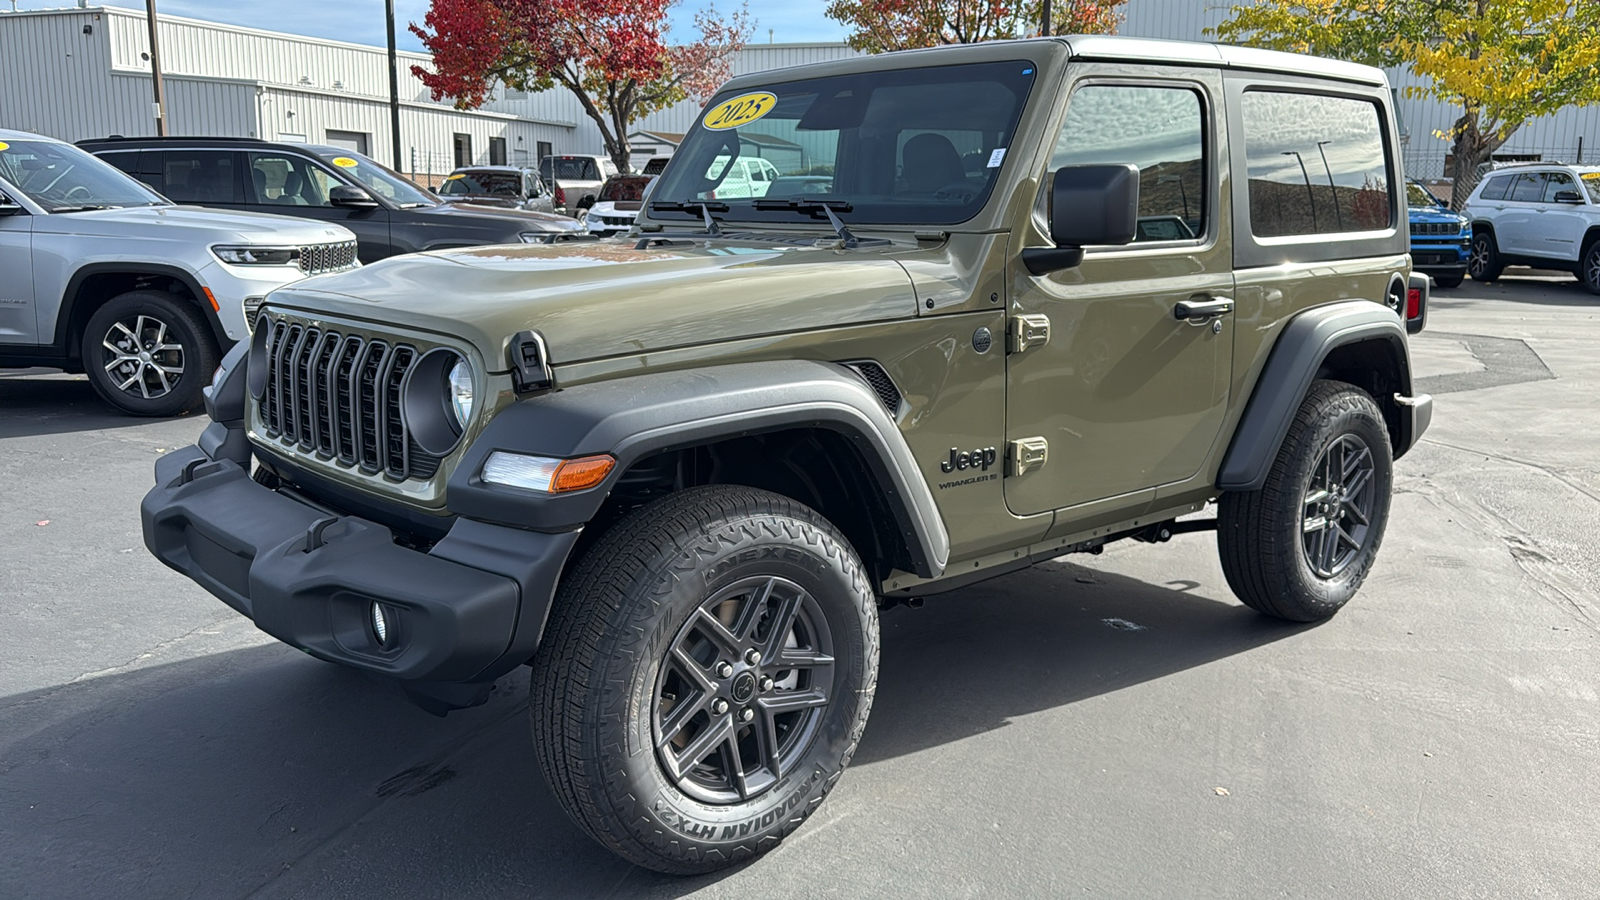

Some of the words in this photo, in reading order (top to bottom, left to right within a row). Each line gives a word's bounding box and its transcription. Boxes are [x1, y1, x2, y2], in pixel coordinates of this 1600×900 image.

[711, 96, 769, 126] 2025
[941, 446, 996, 474] Jeep
[938, 475, 989, 490] WRANGLER
[717, 545, 821, 572] NEXEN
[721, 777, 813, 839] ROADIAN
[659, 806, 718, 840] HTX2
